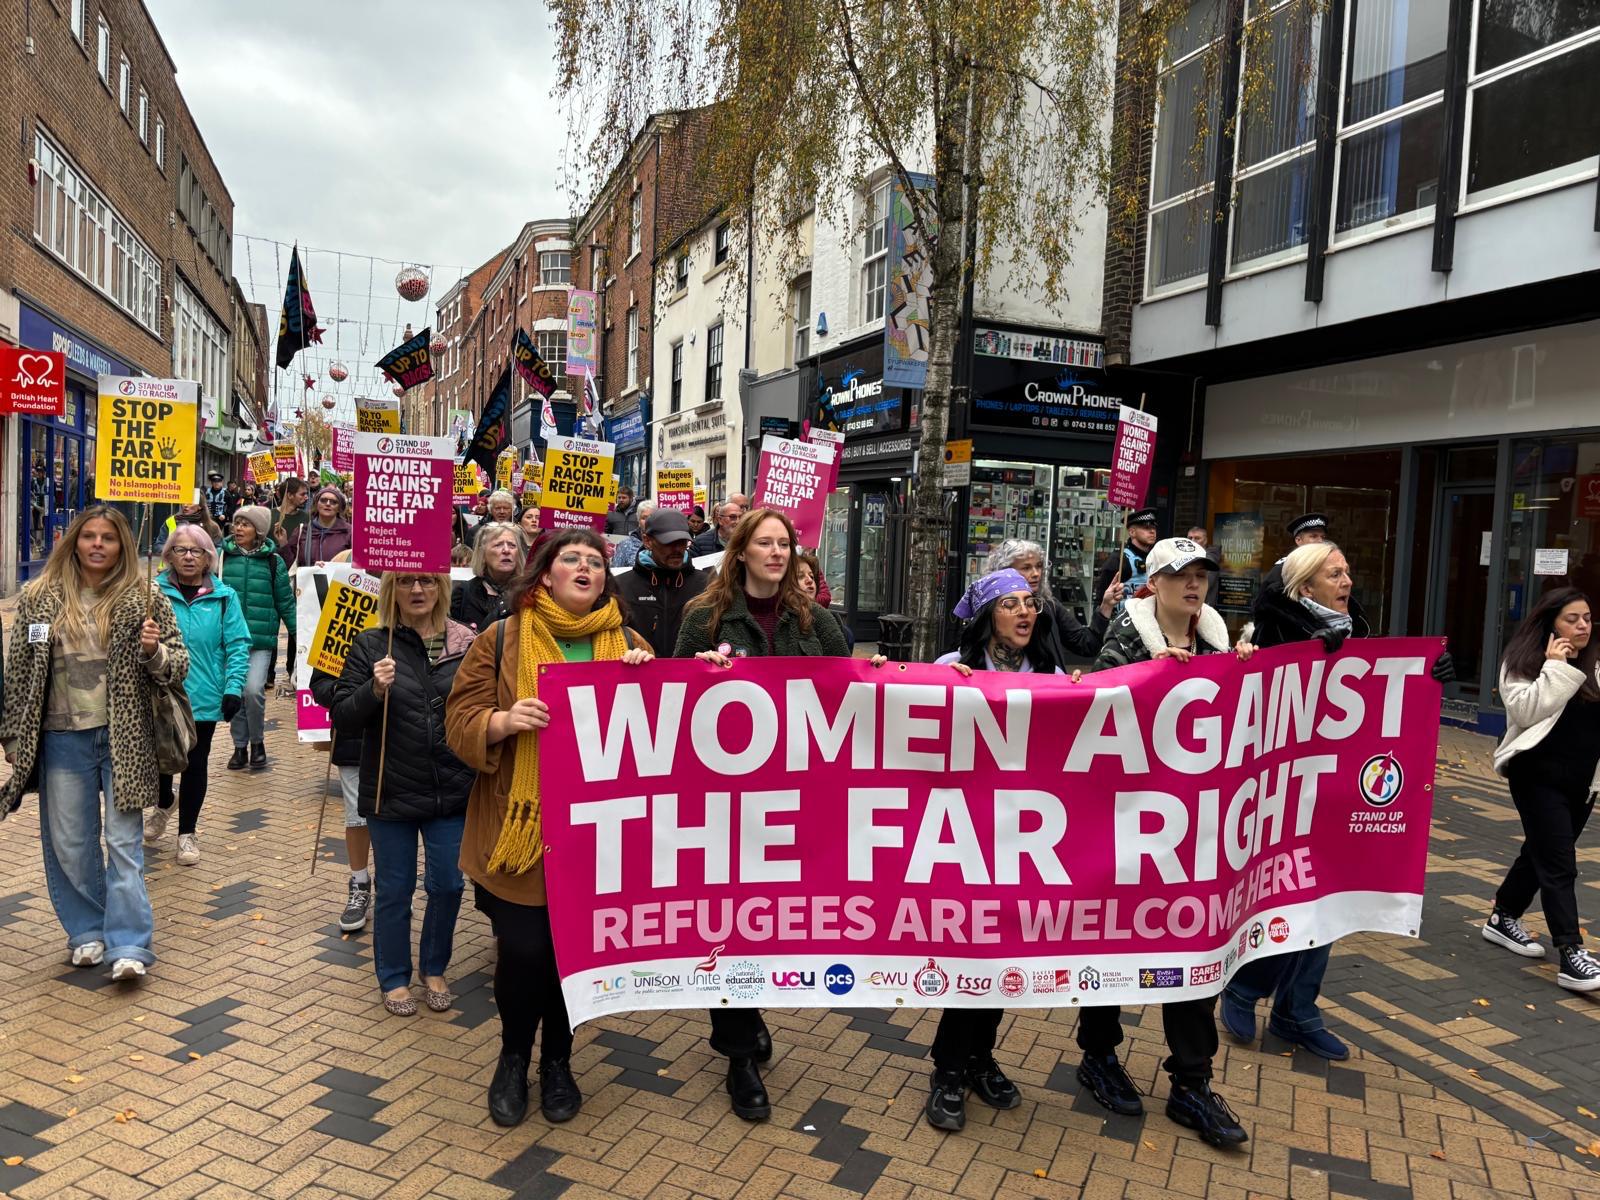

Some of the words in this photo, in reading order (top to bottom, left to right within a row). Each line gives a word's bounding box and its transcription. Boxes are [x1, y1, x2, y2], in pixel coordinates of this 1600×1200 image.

[390, 356, 411, 373] UP
[411, 348, 427, 365] TO
[532, 359, 551, 378] TO
[138, 382, 162, 391] STAND
[164, 384, 174, 392] UP
[11, 392, 36, 402] British
[37, 394, 58, 403] Heart
[150, 390, 178, 400] RACISM
[12, 401, 56, 411] Foundation
[112, 398, 173, 420] STOP
[976, 400, 1003, 411] PHONES
[1010, 404, 1040, 414] LAPTOPS
[1046, 407, 1074, 416] TABLETS
[1080, 410, 1106, 420] REPAIRS
[360, 410, 369, 418] NO
[371, 412, 382, 420] TO
[112, 418, 156, 440] THE
[669, 422, 690, 438] YORKSHIRE
[692, 418, 710, 433] DENTAL
[712, 413, 727, 428] SUITE
[1072, 422, 1086, 430] 0743
[1088, 422, 1095, 430] 52
[1124, 424, 1148, 442] WOMEN
[112, 438, 154, 459] FAR
[396, 440, 418, 448] STAND
[396, 446, 404, 454] TO
[406, 448, 432, 456] RACISM
[792, 444, 808, 452] STAND
[866, 442, 876, 454] SELL
[880, 438, 912, 454] ACCESSORIES
[1120, 436, 1151, 454] AGAINST
[562, 454, 598, 469] STOP
[1120, 447, 1134, 461] THE
[1134, 452, 1148, 465] FAR
[110, 458, 182, 482] RIGHT
[367, 457, 432, 476] WOMEN
[454, 464, 468, 472] TOP
[770, 454, 816, 475] WOMEN
[1117, 458, 1140, 474] RIGHT
[554, 466, 604, 484] RACIST
[658, 472, 692, 480] Refugees
[767, 467, 822, 488] AGAINST
[110, 479, 121, 487] No
[124, 480, 182, 491] Islamophobia
[366, 474, 442, 494] AGAINST
[454, 486, 465, 494] UK
[549, 478, 604, 498] REFORM
[766, 478, 790, 495] THE
[791, 484, 814, 500] FAR
[109, 488, 121, 497] No
[123, 490, 180, 500] antisemitism
[366, 491, 398, 508] THE
[403, 493, 435, 509] FAR
[660, 493, 676, 502] Stop
[678, 492, 690, 500] the
[764, 492, 800, 509] RIGHT
[566, 496, 584, 509] UK
[672, 502, 690, 510] right
[366, 507, 417, 524] RIGHT
[554, 510, 592, 523] Refugees
[370, 526, 397, 536] Reject
[554, 520, 591, 530] welcome
[369, 537, 394, 546] racist
[396, 538, 412, 546] lies
[1221, 538, 1234, 553] WE
[1236, 538, 1255, 553] HAVE
[369, 548, 408, 558] Refugees
[369, 558, 382, 568] not
[385, 558, 394, 568] to
[396, 558, 422, 569] blame
[364, 578, 381, 589] STAN
[335, 603, 368, 629] THE
[322, 634, 350, 660] RIG
[320, 651, 329, 660] No
[317, 660, 327, 669] No
[567, 679, 1031, 782] WOMEN
[1063, 657, 1426, 774] AGAINST
[1350, 812, 1386, 822] STAND
[1388, 812, 1404, 822] UP
[570, 789, 802, 895] THE
[848, 788, 1072, 885] FAR
[1115, 754, 1337, 885] RIGHT
[1348, 823, 1364, 832] TO
[1365, 823, 1406, 833] RACISM
[593, 895, 876, 953] REFUGEES
[888, 897, 1000, 944] ARE
[1017, 885, 1244, 942] WELCOME
[1244, 847, 1316, 911] HERE
[1270, 922, 1288, 930] HOMES
[1280, 928, 1288, 936] ALL
[1192, 966, 1214, 976] CARE
[1192, 972, 1220, 984] CALAIS
[592, 976, 626, 994] TUC
[634, 975, 680, 988] UNISON
[687, 972, 720, 986] unite
[726, 976, 766, 984] education
[772, 972, 815, 986] ucu
[826, 973, 853, 987] pcs
[870, 972, 908, 986] CWU
[956, 974, 992, 990] tssa
